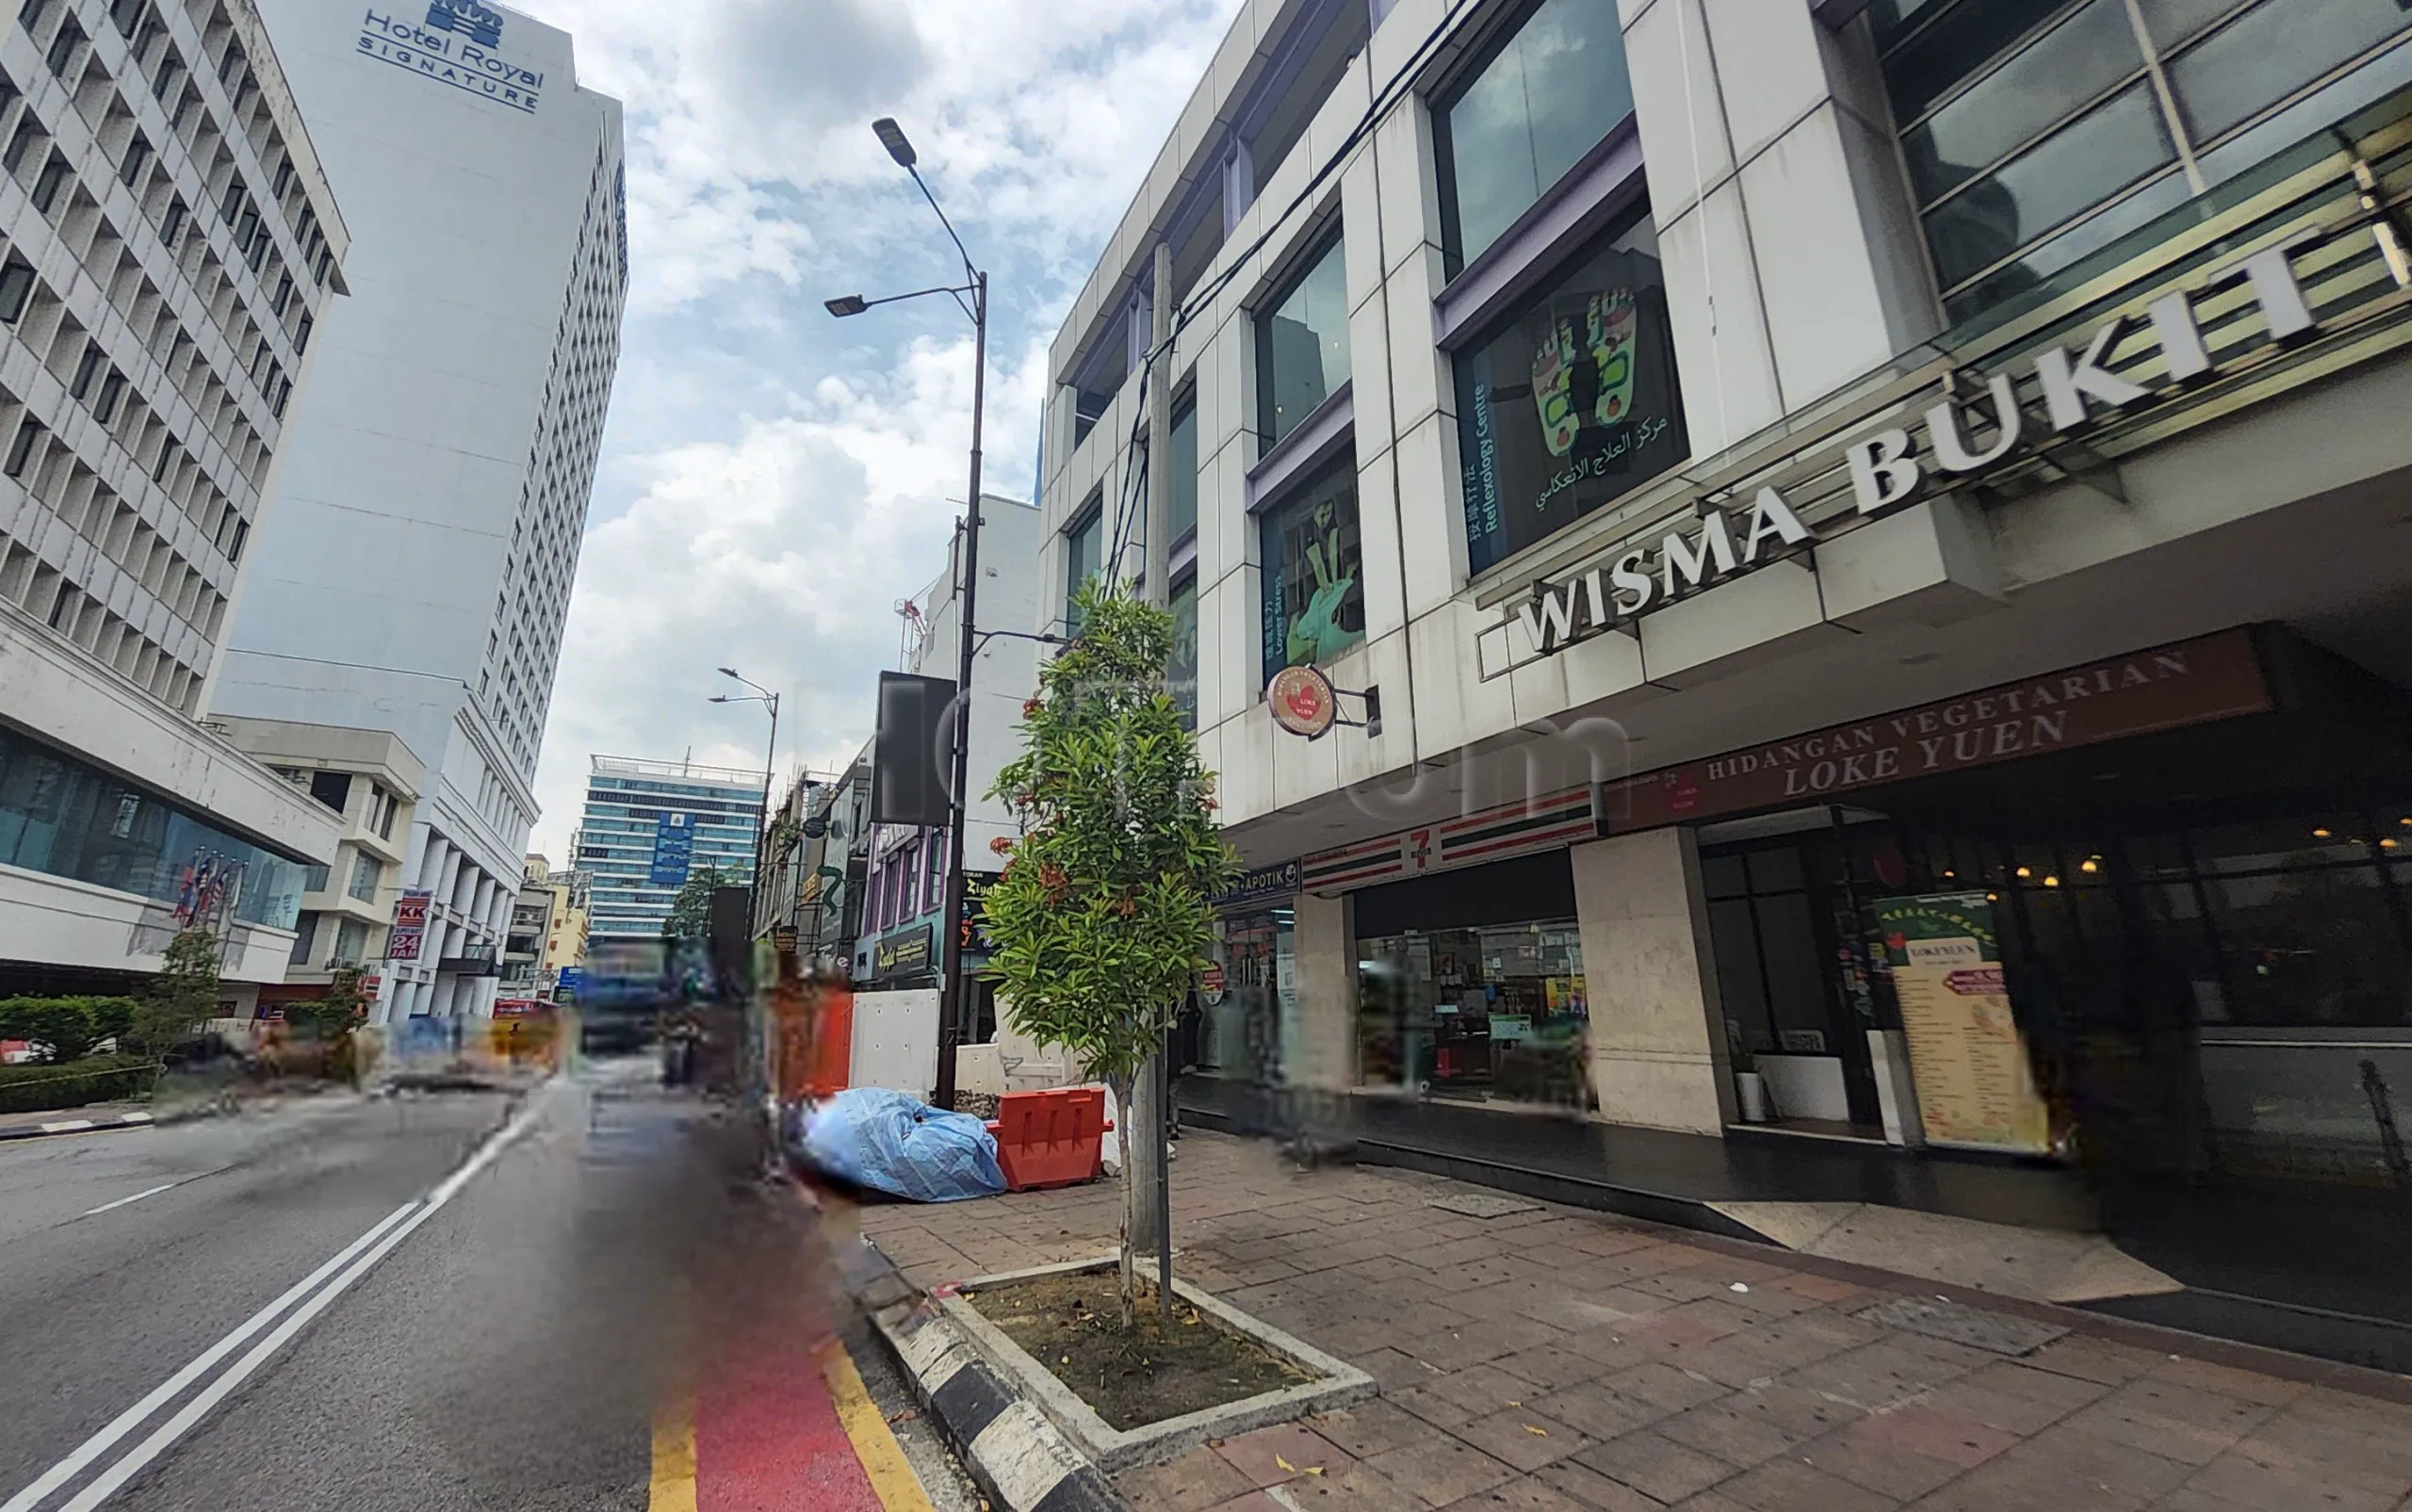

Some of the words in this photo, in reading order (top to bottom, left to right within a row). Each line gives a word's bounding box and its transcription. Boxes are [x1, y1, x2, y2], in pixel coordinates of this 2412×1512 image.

[358, 36, 538, 110] SIGNATURE
[364, 8, 450, 56] Hotel
[461, 43, 544, 89] Royal
[1474, 382, 1489, 438] Centre
[1636, 415, 1668, 450] مركز
[1517, 484, 1817, 656] WISMA
[1845, 224, 2322, 520] BUKIT
[1480, 437, 1499, 534] Reflexology
[1706, 725, 1876, 781] HIDANGAN
[1889, 649, 2191, 740] VEGETARIAN
[1783, 745, 1901, 798] LOKE
[1916, 708, 2068, 771] YUEN
[1410, 829, 1429, 869] 7
[1245, 870, 1284, 891] APOTIK
[399, 907, 426, 918] KK
[391, 949, 417, 958] JAM
[392, 935, 419, 949] 24
